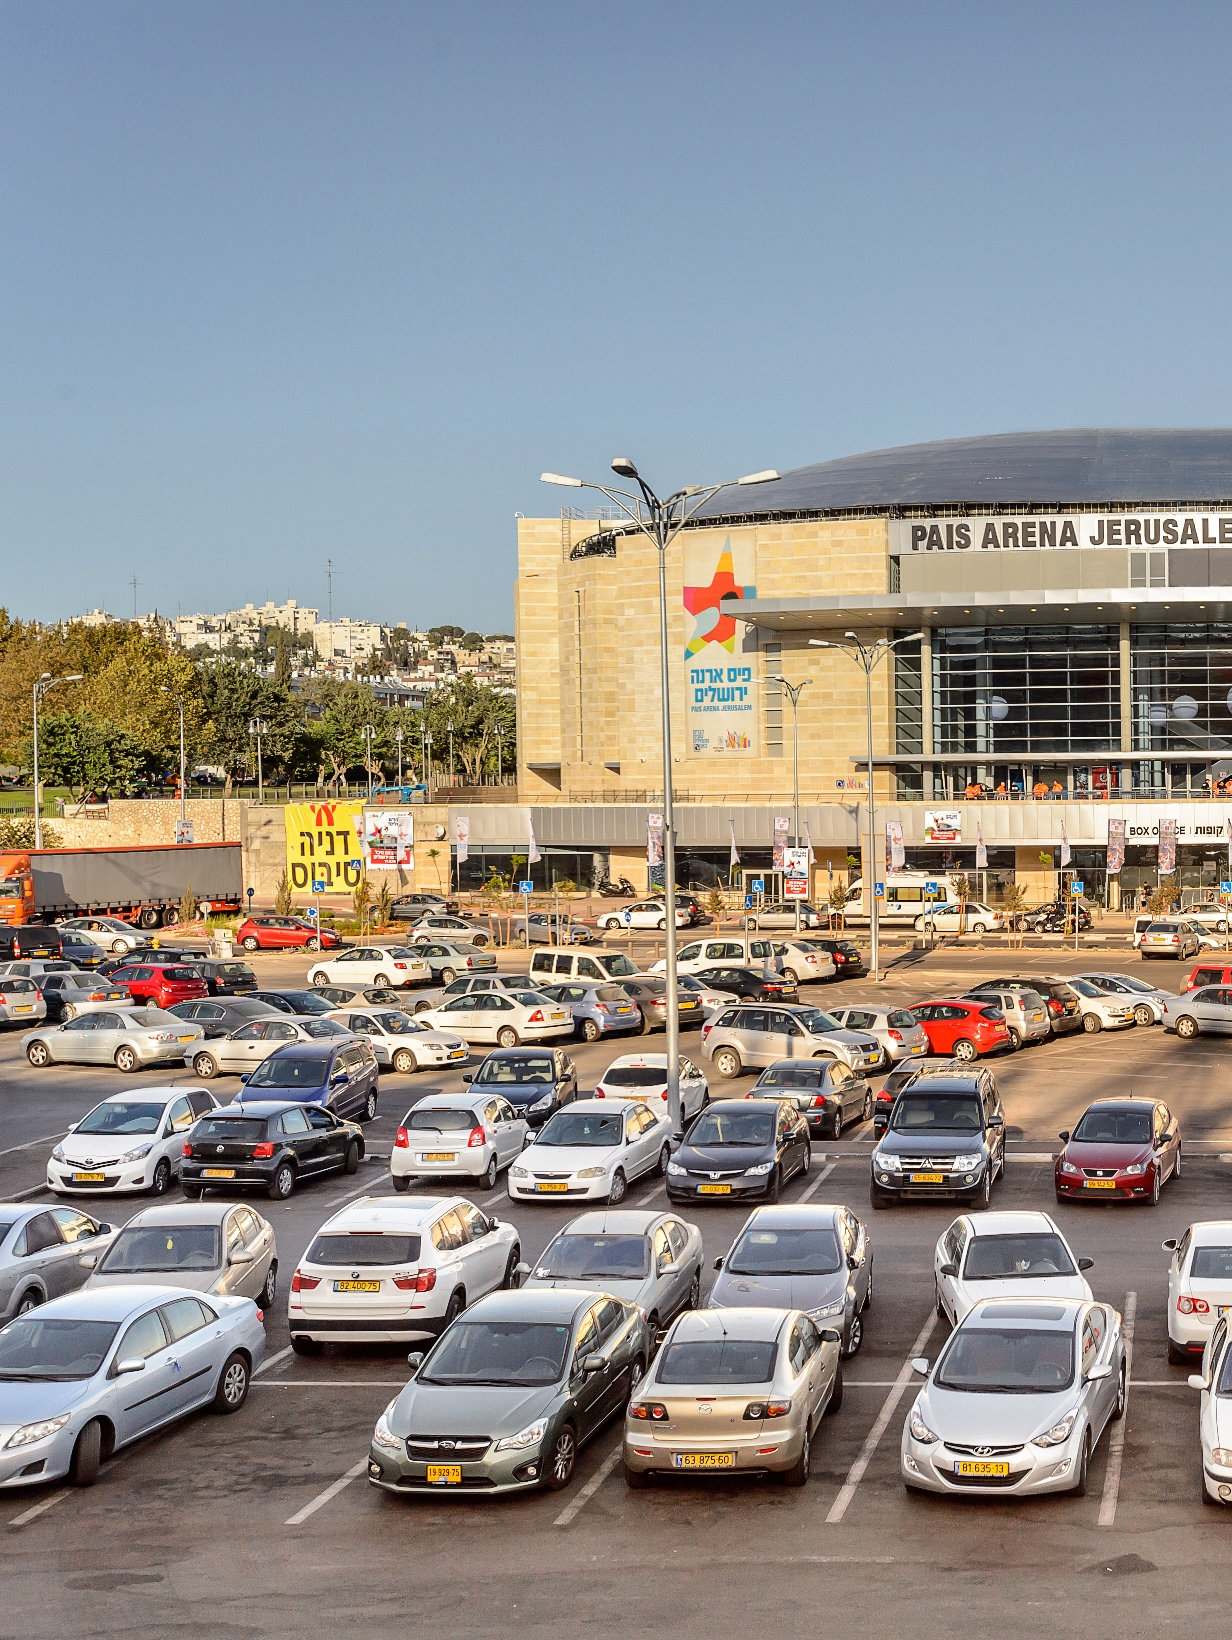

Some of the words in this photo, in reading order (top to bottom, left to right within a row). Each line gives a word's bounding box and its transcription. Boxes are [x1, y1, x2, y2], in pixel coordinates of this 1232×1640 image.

[911, 522, 971, 551] PAIS
[981, 520, 1078, 549] ARENA
[690, 668, 724, 684] ארנה
[727, 667, 752, 683] פיס
[694, 685, 748, 703] ירושלים
[1129, 826, 1150, 836] BOX
[1151, 826, 1186, 836] OCE
[1194, 825, 1224, 838] קופות
[299, 830, 350, 857] דניה
[291, 861, 361, 889] סיבוס
